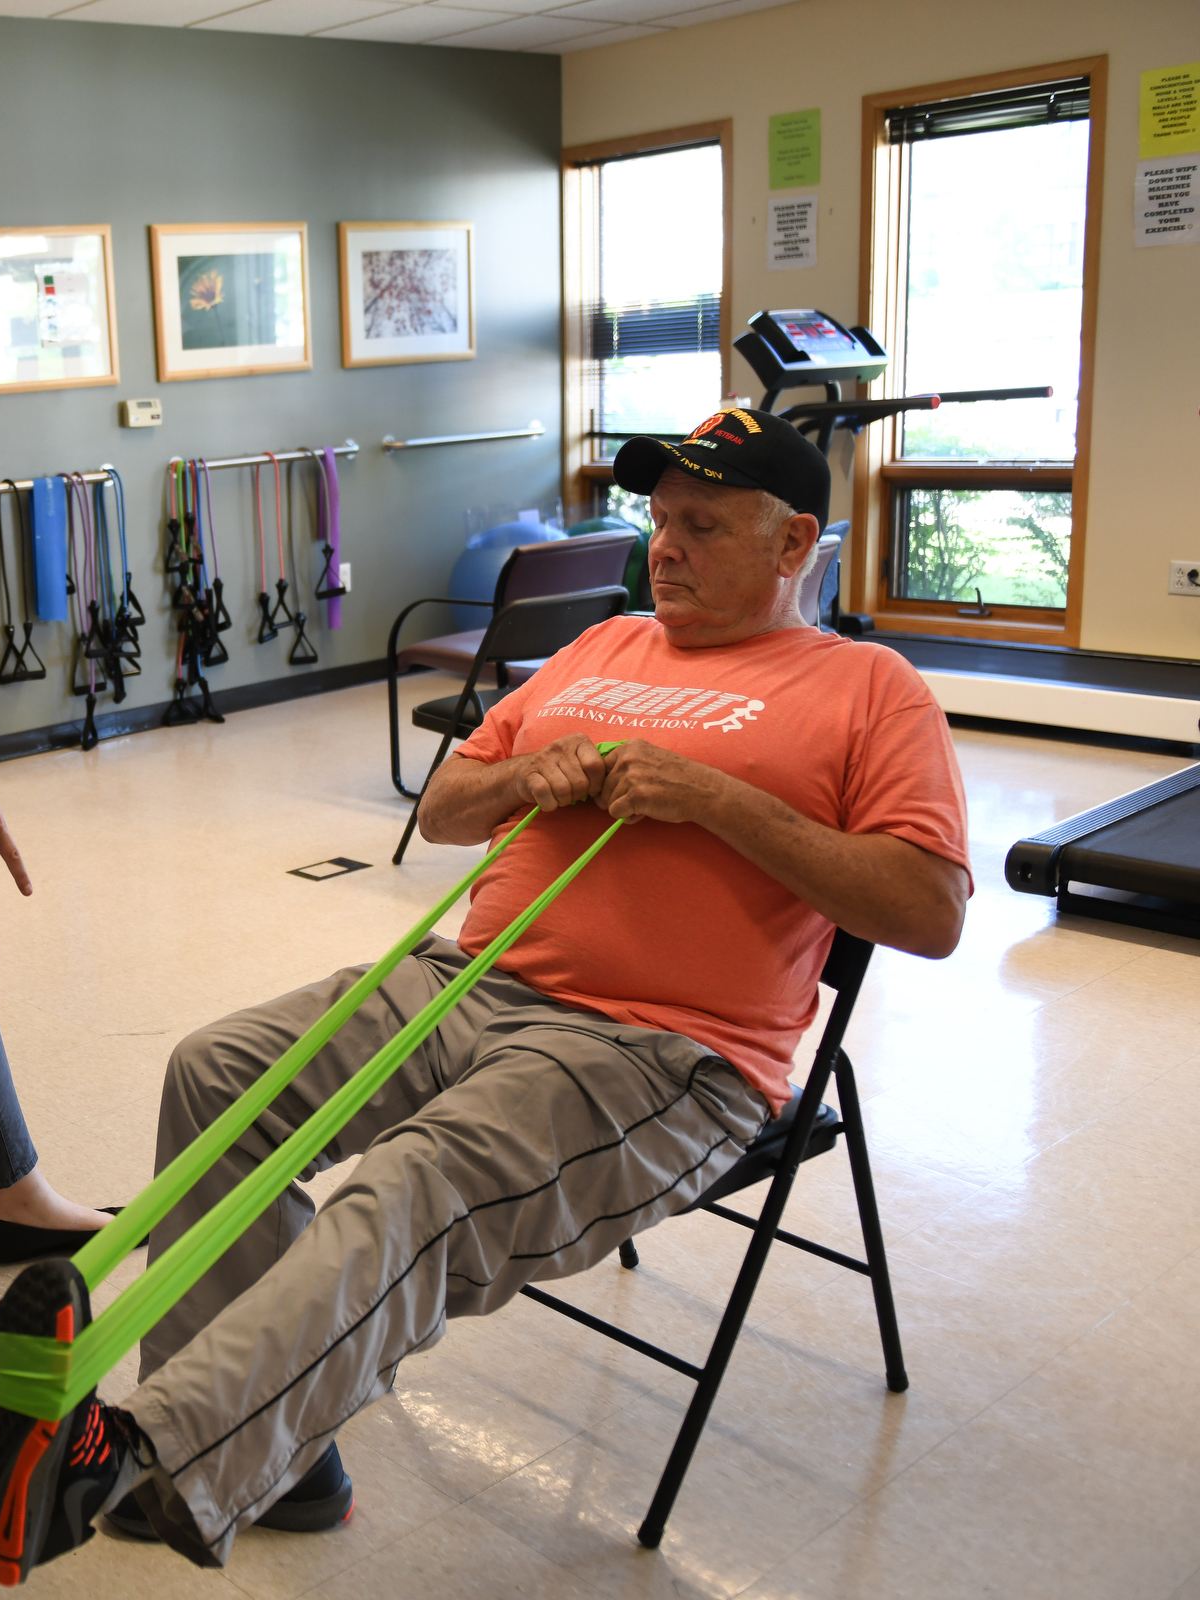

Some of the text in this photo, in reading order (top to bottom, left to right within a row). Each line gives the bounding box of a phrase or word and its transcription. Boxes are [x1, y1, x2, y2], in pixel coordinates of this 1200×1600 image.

[1144, 165, 1198, 177] PLEASE WIPE
[1148, 177, 1174, 185] DOWN
[1148, 182, 1191, 193] MACHINES
[1148, 193, 1172, 201] WHEN
[1144, 207, 1195, 218] COMPLETED
[1145, 224, 1186, 234] EXERCISE
[715, 429, 744, 445] VETERAN
[680, 457, 700, 471] INF
[704, 468, 722, 480] DIV
[536, 706, 698, 729] VETERANS IN ACTION!
